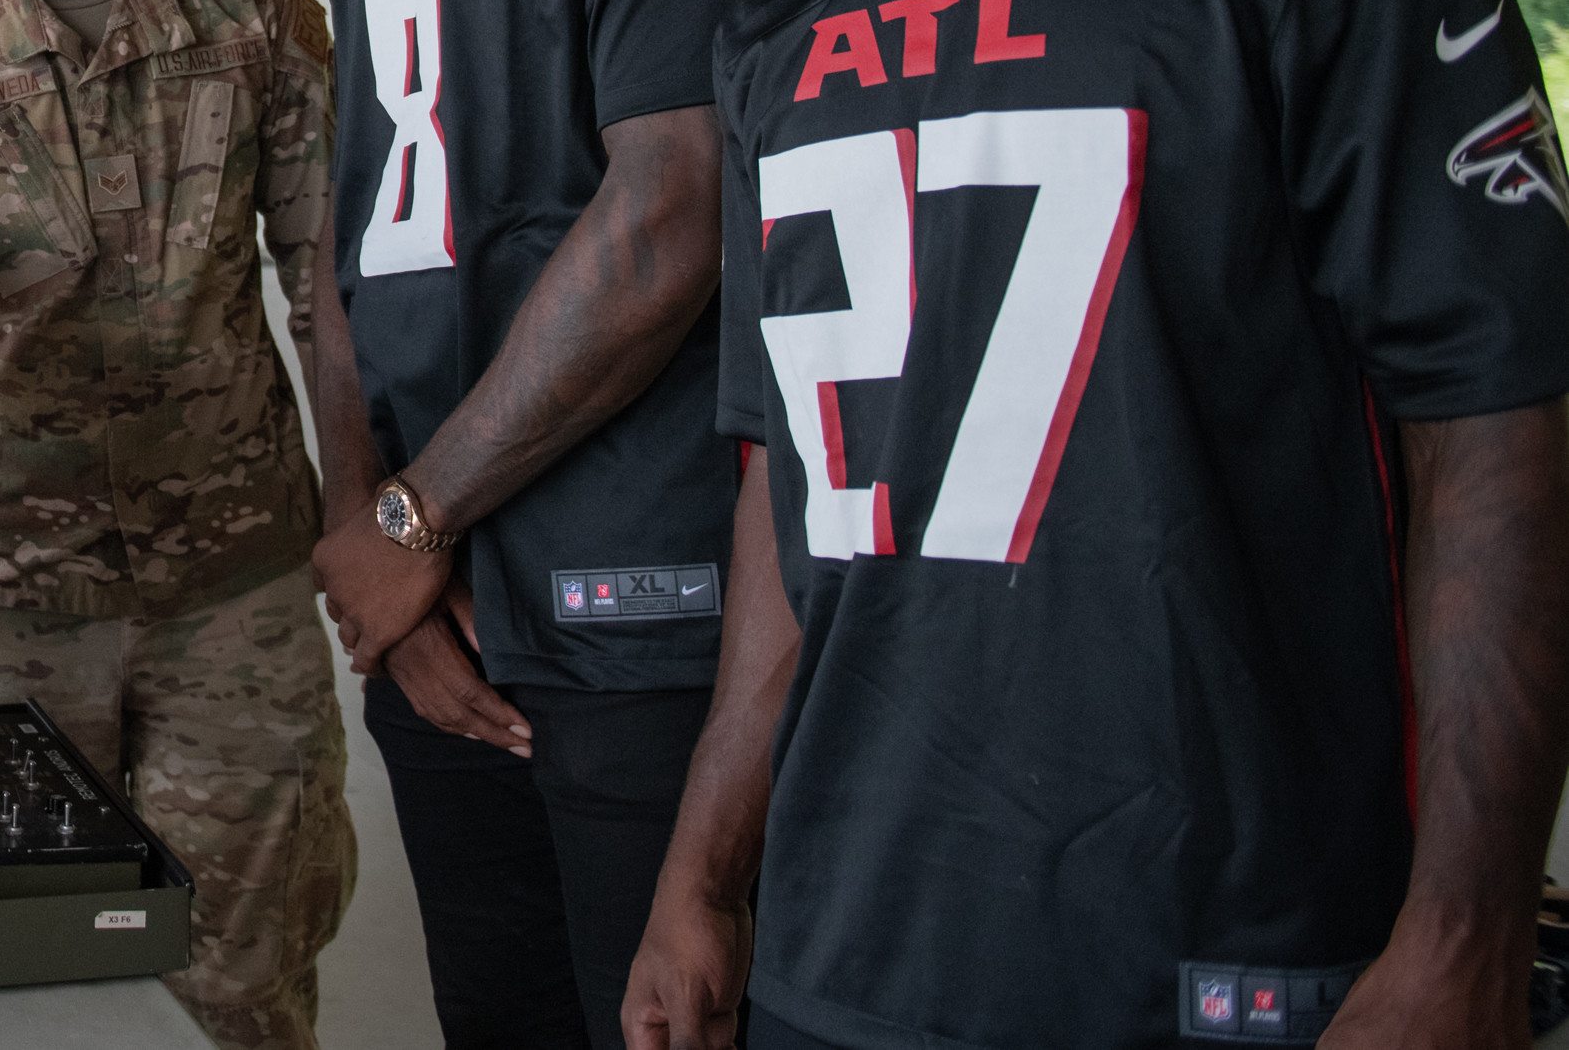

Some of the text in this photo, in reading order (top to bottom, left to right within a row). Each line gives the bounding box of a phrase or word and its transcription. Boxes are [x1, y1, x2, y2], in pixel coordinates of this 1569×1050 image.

[187, 49, 212, 71] AIR
[213, 39, 262, 69] FORCE
[758, 107, 1149, 564] 27
[628, 574, 665, 594] XL
[566, 592, 582, 608] NFL
[108, 915, 131, 924] X3 F6
[1203, 996, 1228, 1019] NFL
